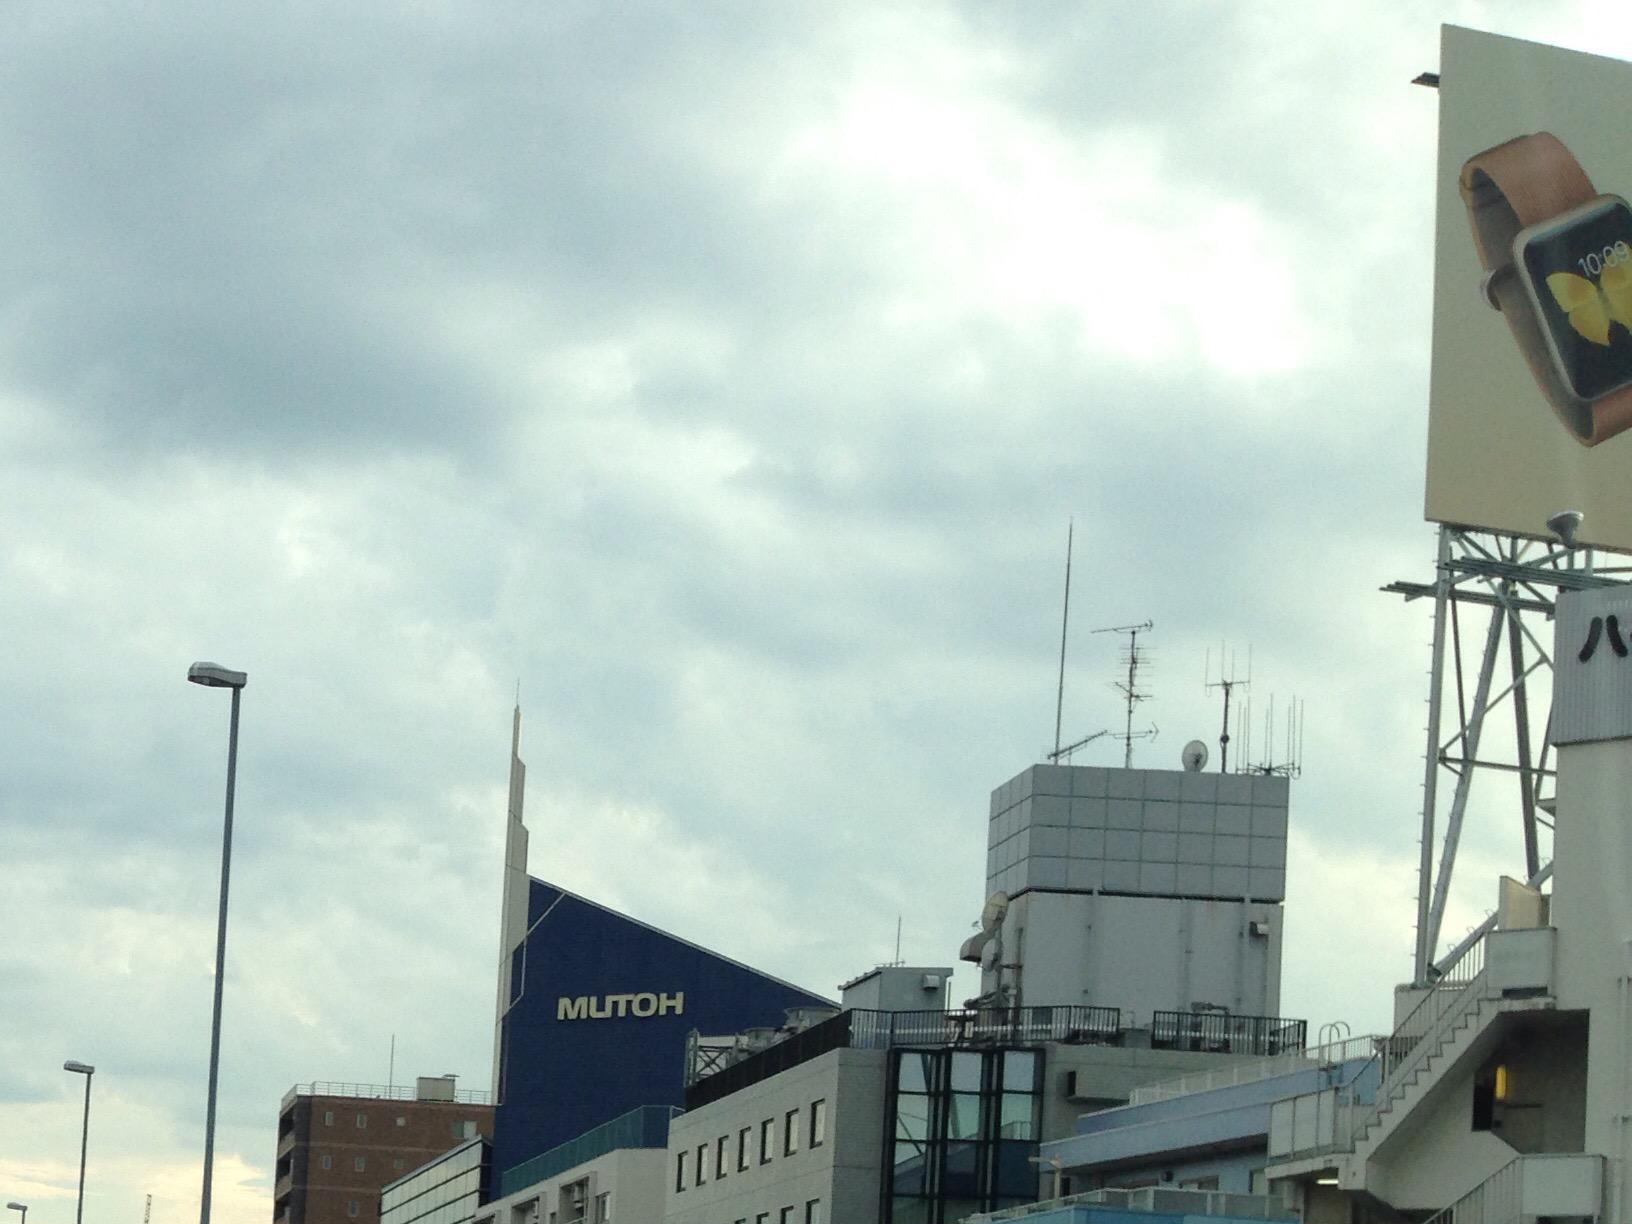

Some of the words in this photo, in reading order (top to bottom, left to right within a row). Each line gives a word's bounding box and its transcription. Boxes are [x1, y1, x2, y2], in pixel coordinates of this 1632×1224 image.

[1577, 240, 1628, 278] 10:09
[1578, 614, 1632, 663] ハ
[557, 991, 685, 1020] MUTOH
